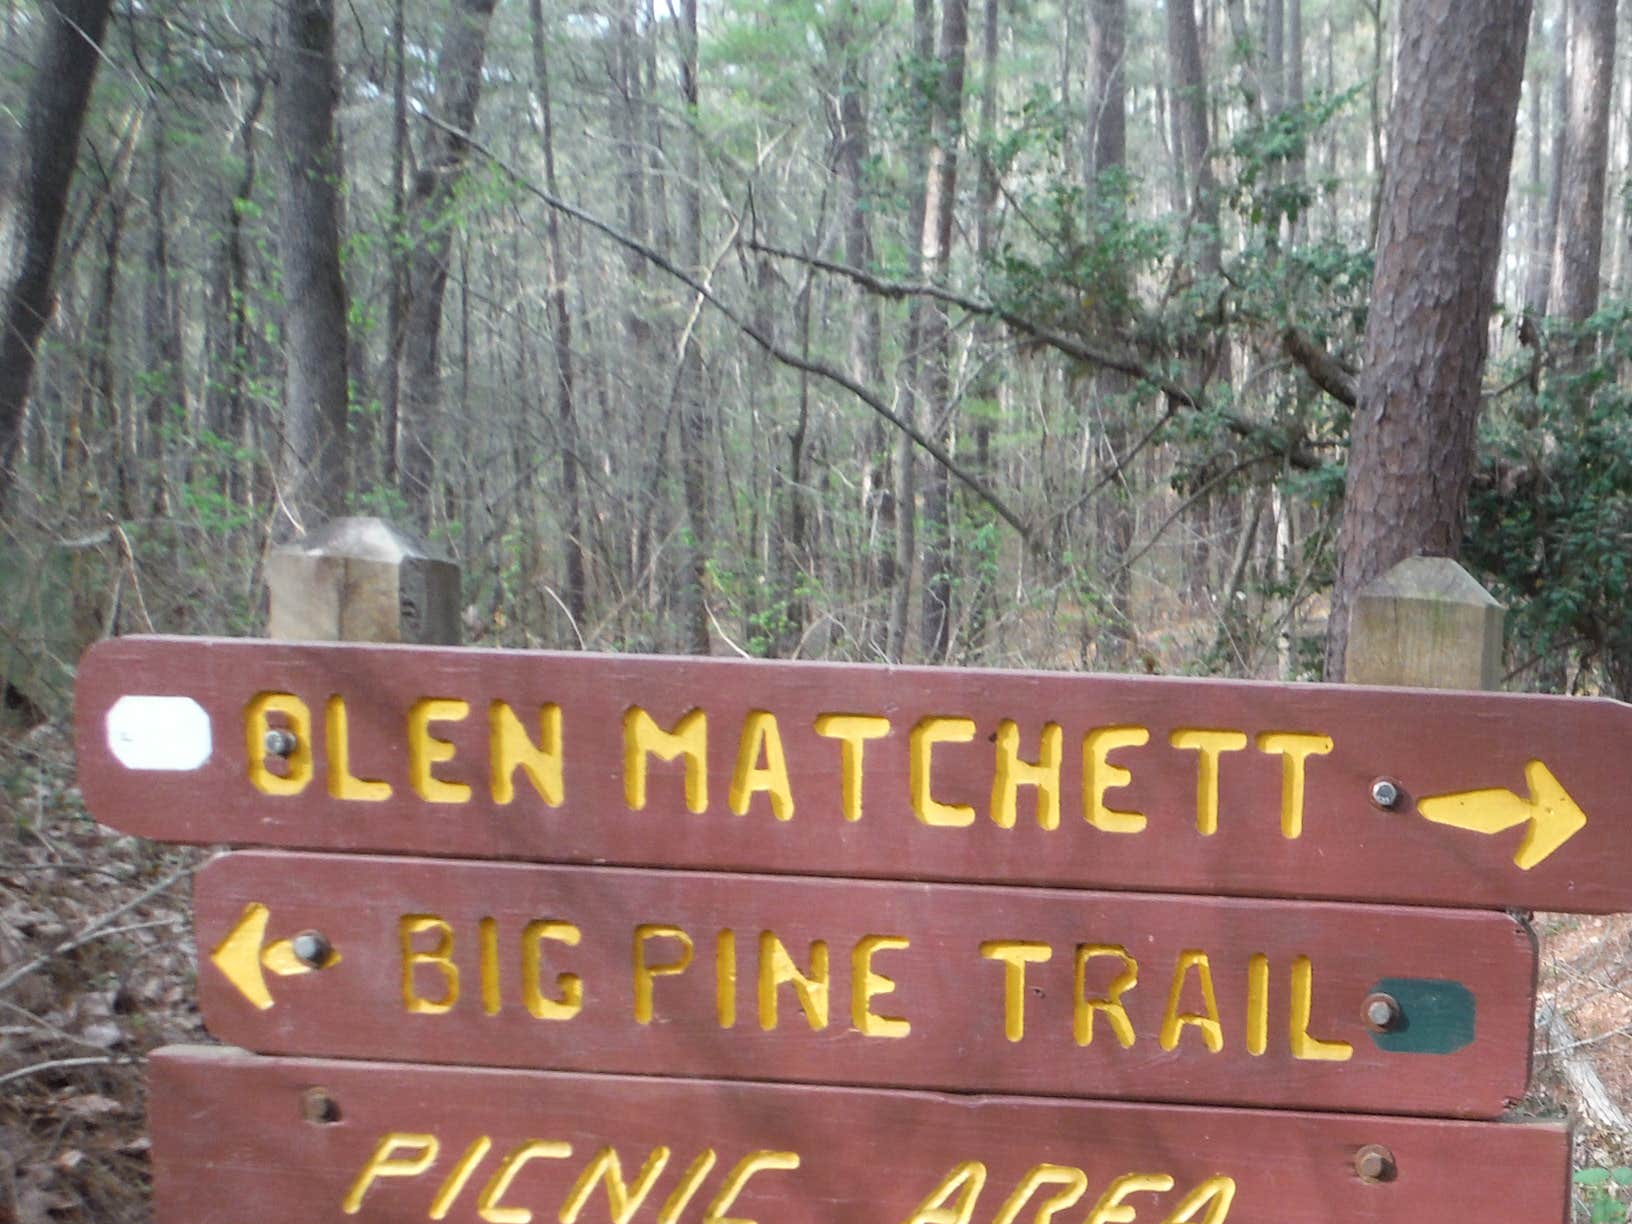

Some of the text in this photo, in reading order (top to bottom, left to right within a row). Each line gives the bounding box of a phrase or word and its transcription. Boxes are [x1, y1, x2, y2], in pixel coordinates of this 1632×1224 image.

[244, 690, 1334, 839] OLEN MATCHETT
[400, 913, 1353, 1061] BIG PINE TRAIL
